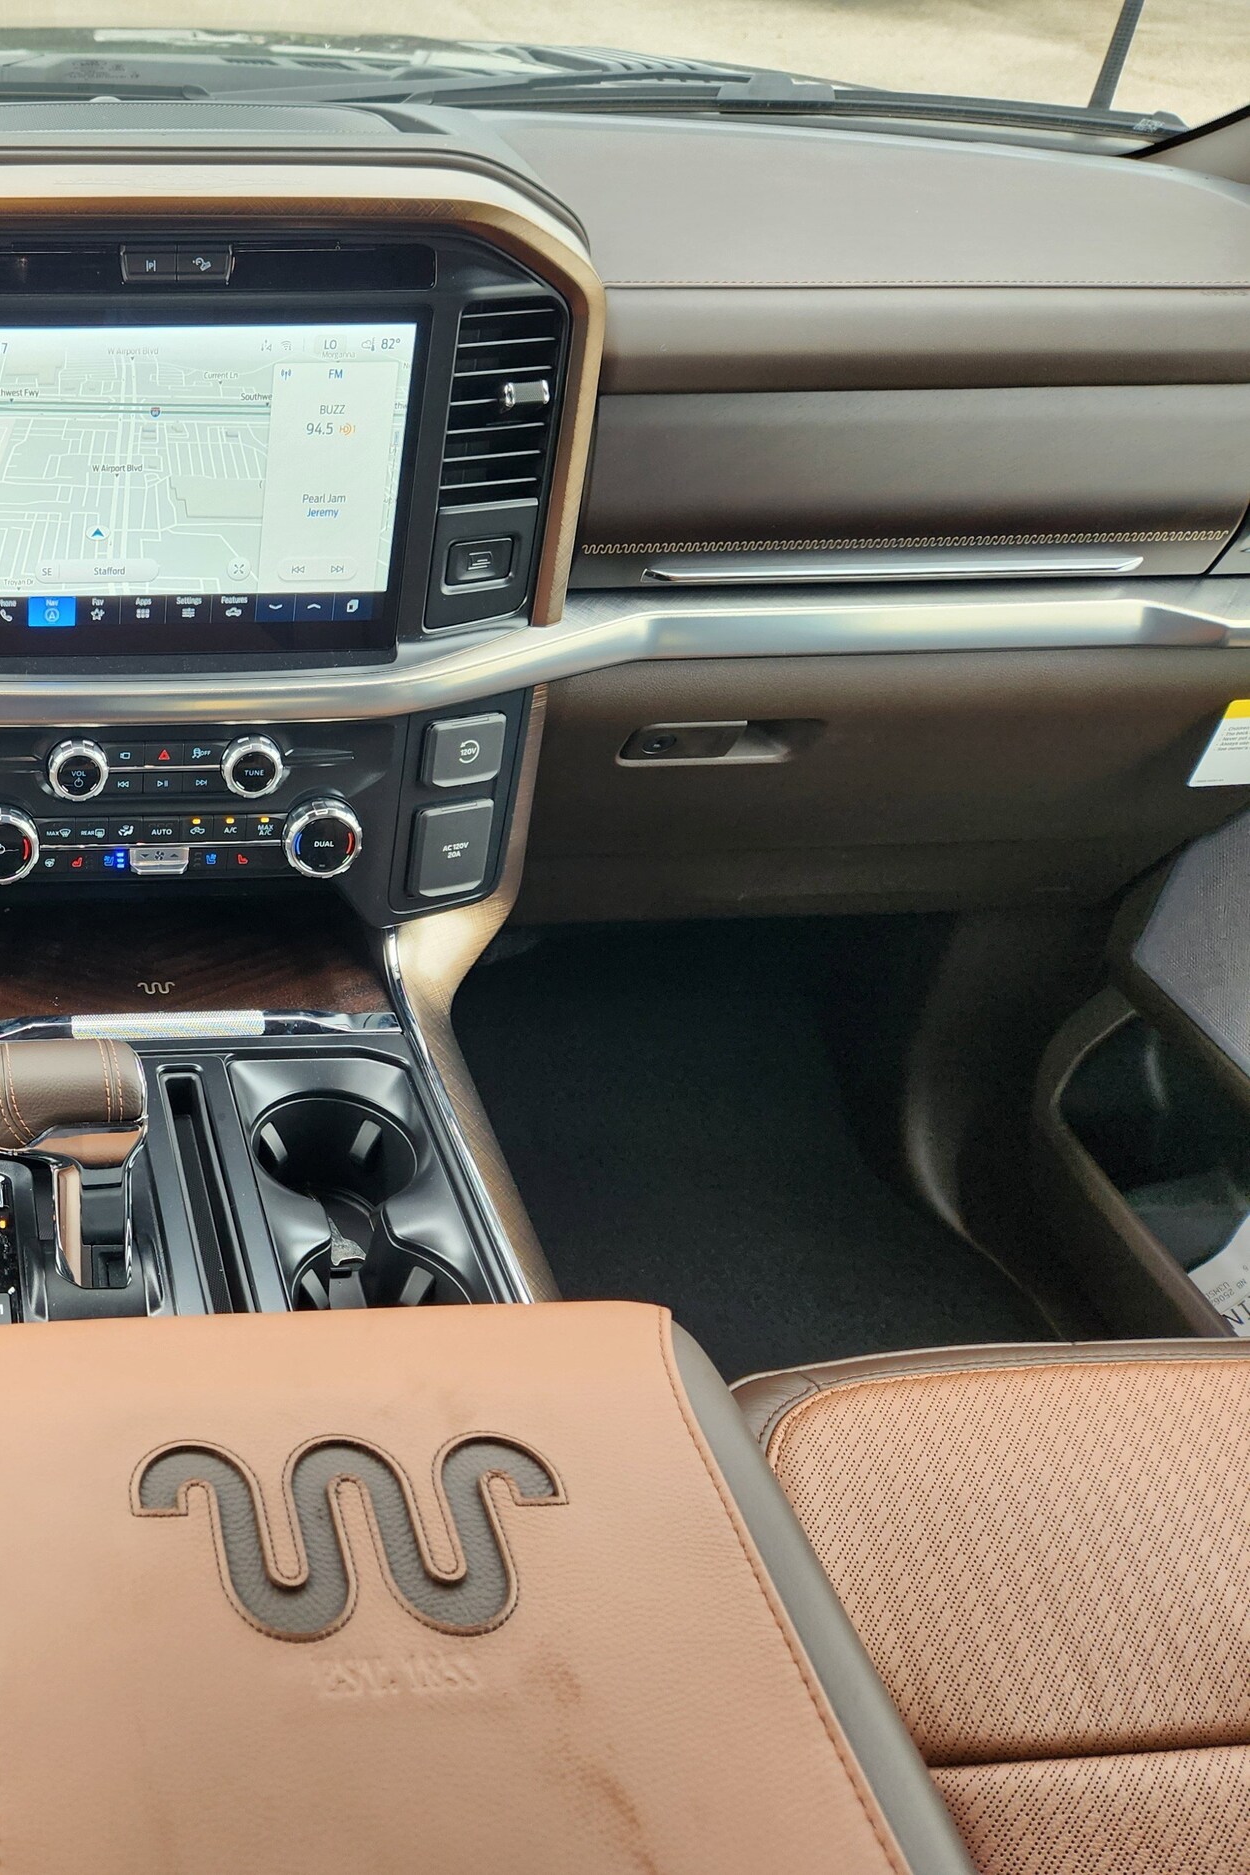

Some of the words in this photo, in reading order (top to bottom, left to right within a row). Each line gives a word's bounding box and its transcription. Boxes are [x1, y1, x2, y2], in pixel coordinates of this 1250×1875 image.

[324, 340, 338, 350] LO
[116, 347, 142, 358] Airport
[143, 347, 159, 356] Blvd
[203, 371, 228, 380] Current
[230, 371, 239, 380] Ln
[328, 369, 343, 379] FM
[24, 389, 40, 400] Fwy
[319, 404, 346, 415] BUZZ
[306, 422, 334, 435] 94.5
[92, 465, 100, 473] W
[101, 464, 126, 476] Airport
[126, 464, 143, 473] Blvd
[302, 494, 325, 504] Pearl
[326, 494, 347, 504] Jam
[306, 507, 339, 519] Jeremy
[41, 567, 53, 577] SE
[93, 566, 126, 577] Stafford
[46, 599, 59, 607] Nav
[91, 598, 105, 607] Fav
[135, 597, 152, 608] Apps
[176, 595, 203, 606] Settings
[220, 595, 249, 605] Features
[460, 747, 477, 756] 120V
[244, 769, 265, 777] TUNE
[46, 829, 59, 837] MAX
[80, 829, 95, 837] REAR
[151, 828, 173, 837] AUTO
[223, 826, 239, 835] A/C
[257, 824, 275, 832] MAX
[258, 829, 273, 837] A/C
[313, 839, 335, 849] DUAL
[452, 841, 470, 851] 120V
[447, 850, 462, 859] 20A
